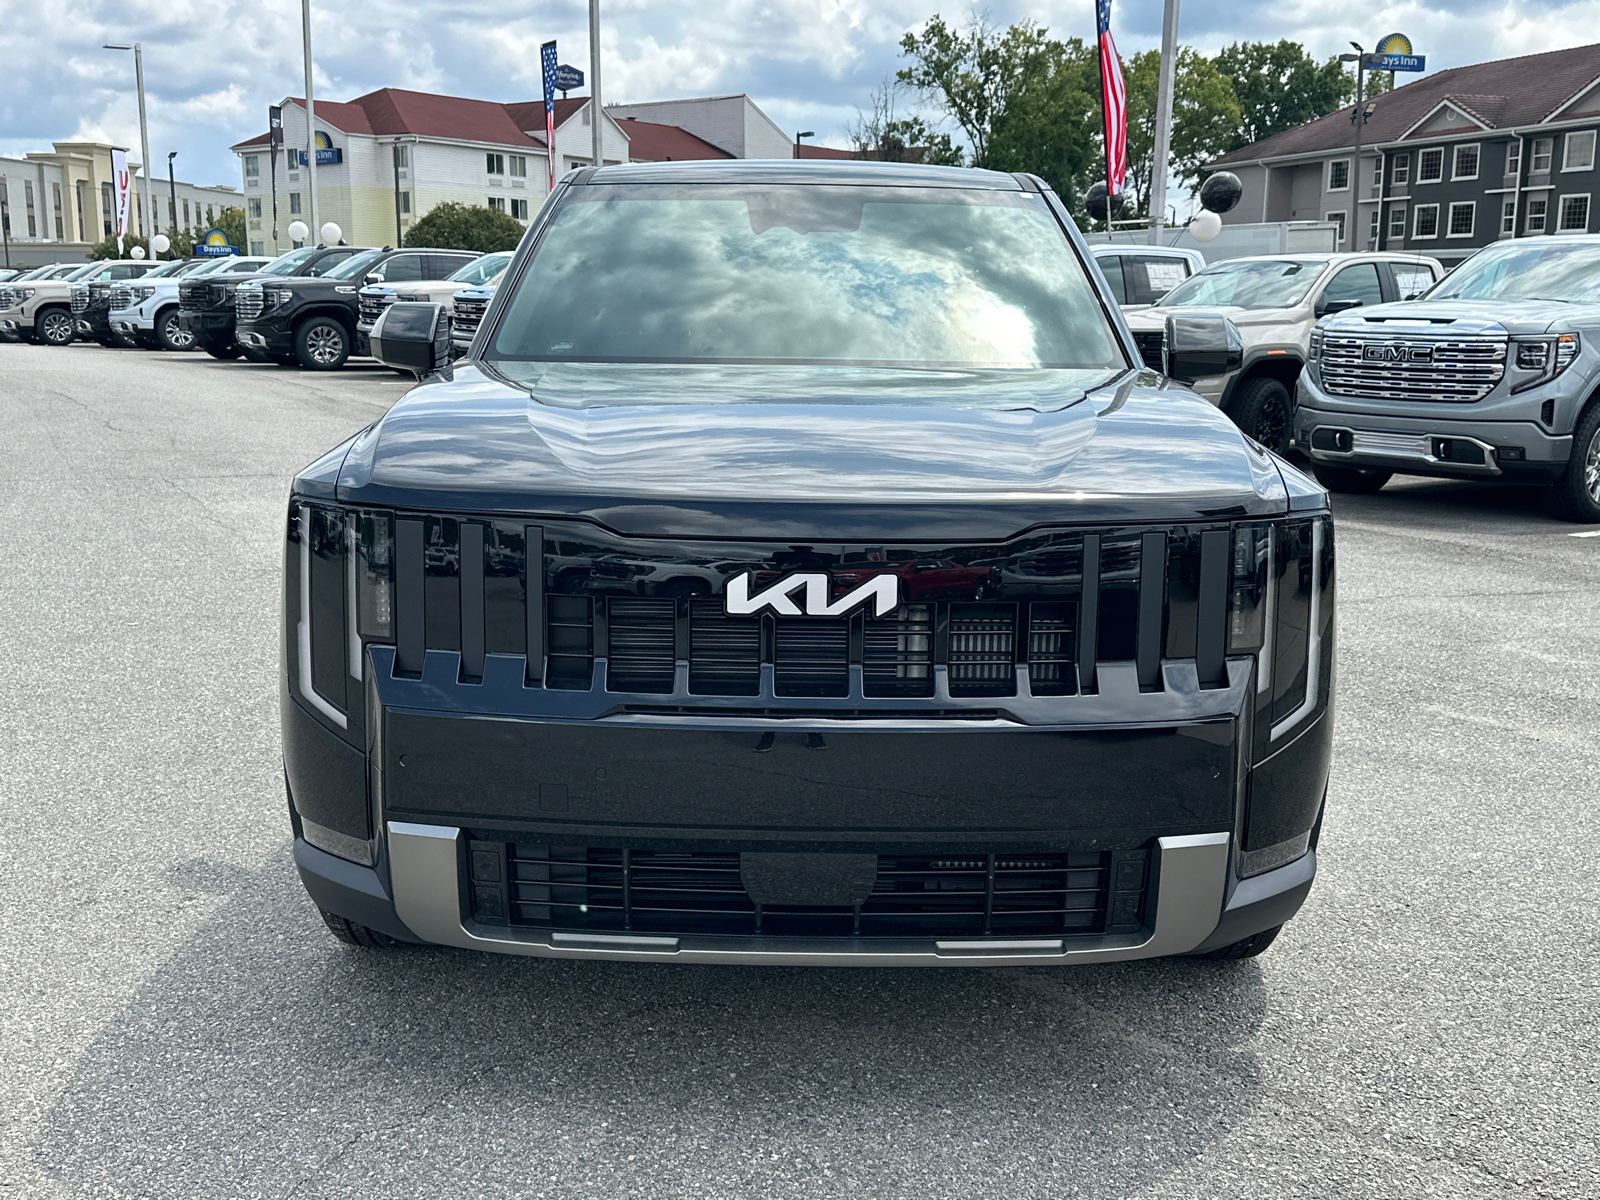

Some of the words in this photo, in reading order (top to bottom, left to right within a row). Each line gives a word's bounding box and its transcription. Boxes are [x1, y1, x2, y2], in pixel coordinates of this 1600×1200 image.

[1379, 56, 1399, 66] ays
[1400, 55, 1418, 66] Inn
[320, 150, 332, 159] Inn
[203, 245, 220, 254] Days
[220, 245, 232, 253] Inn
[1364, 345, 1432, 362] GMC
